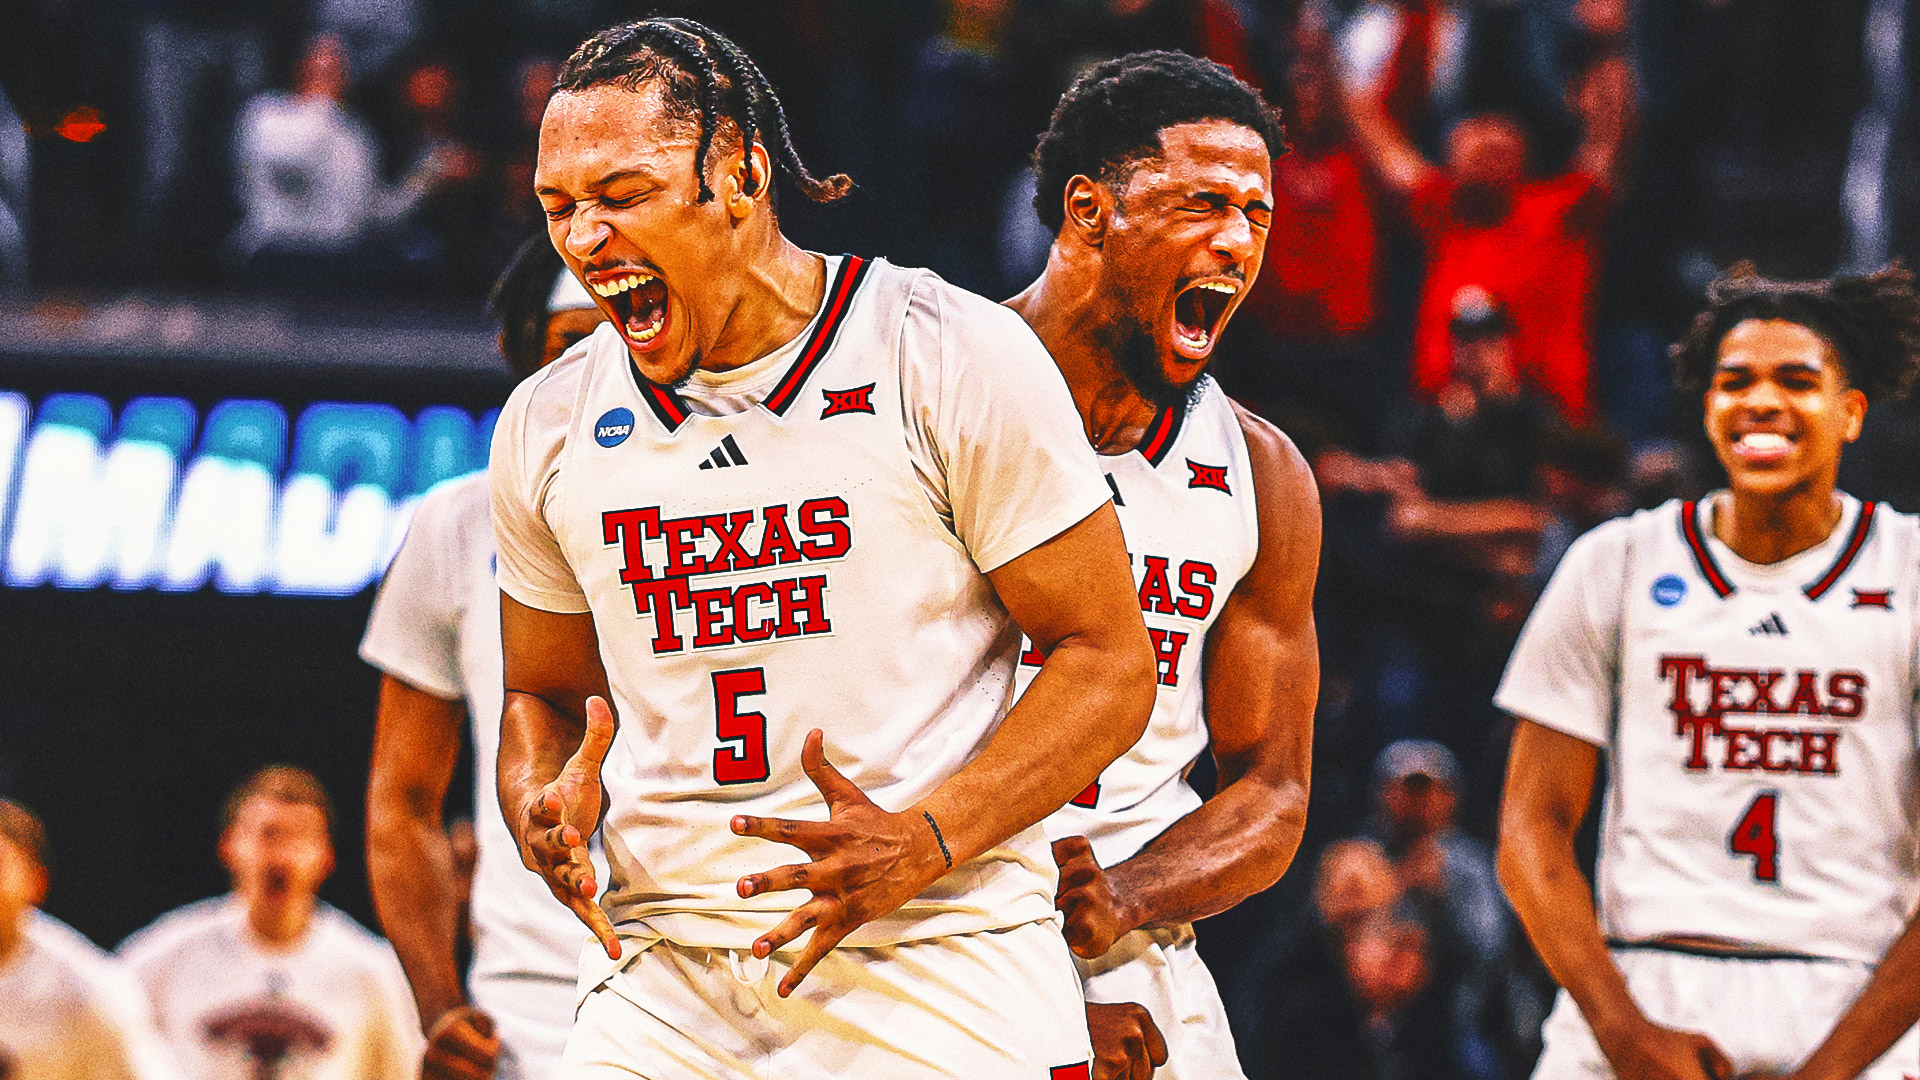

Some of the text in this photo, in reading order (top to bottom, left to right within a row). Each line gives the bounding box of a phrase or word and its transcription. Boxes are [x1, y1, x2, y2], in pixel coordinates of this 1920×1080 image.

[597, 424, 631, 438] NCAA
[602, 496, 852, 584] TEXAS
[634, 574, 833, 655] TECH
[711, 666, 770, 786] 5
[1659, 654, 1868, 718] TEXAS
[1675, 711, 1840, 774] TECH
[1728, 789, 1780, 887] 4
